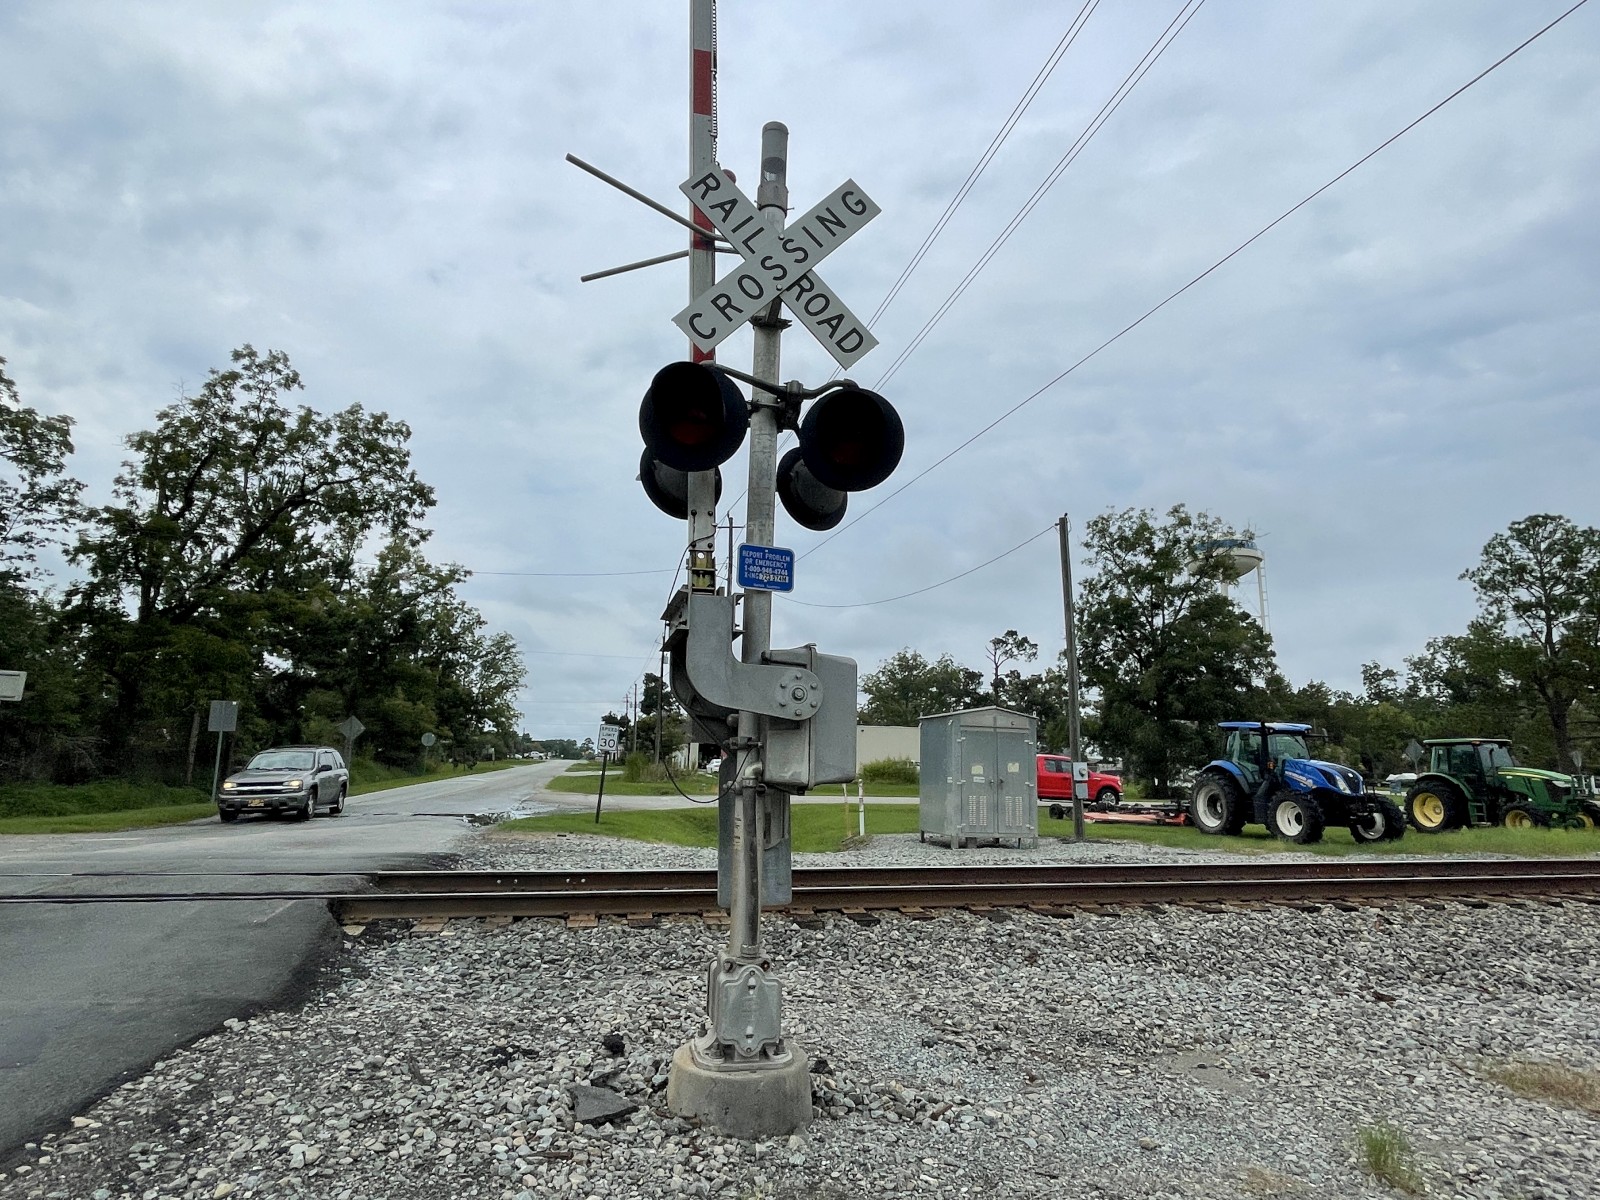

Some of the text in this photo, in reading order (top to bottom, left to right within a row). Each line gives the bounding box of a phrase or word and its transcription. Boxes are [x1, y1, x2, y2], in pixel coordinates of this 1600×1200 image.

[688, 190, 867, 340] CROSSING
[742, 550, 790, 562] REPORT PROBLEM
[755, 559, 788, 569] EMERGENCY
[600, 738, 615, 748] 30
